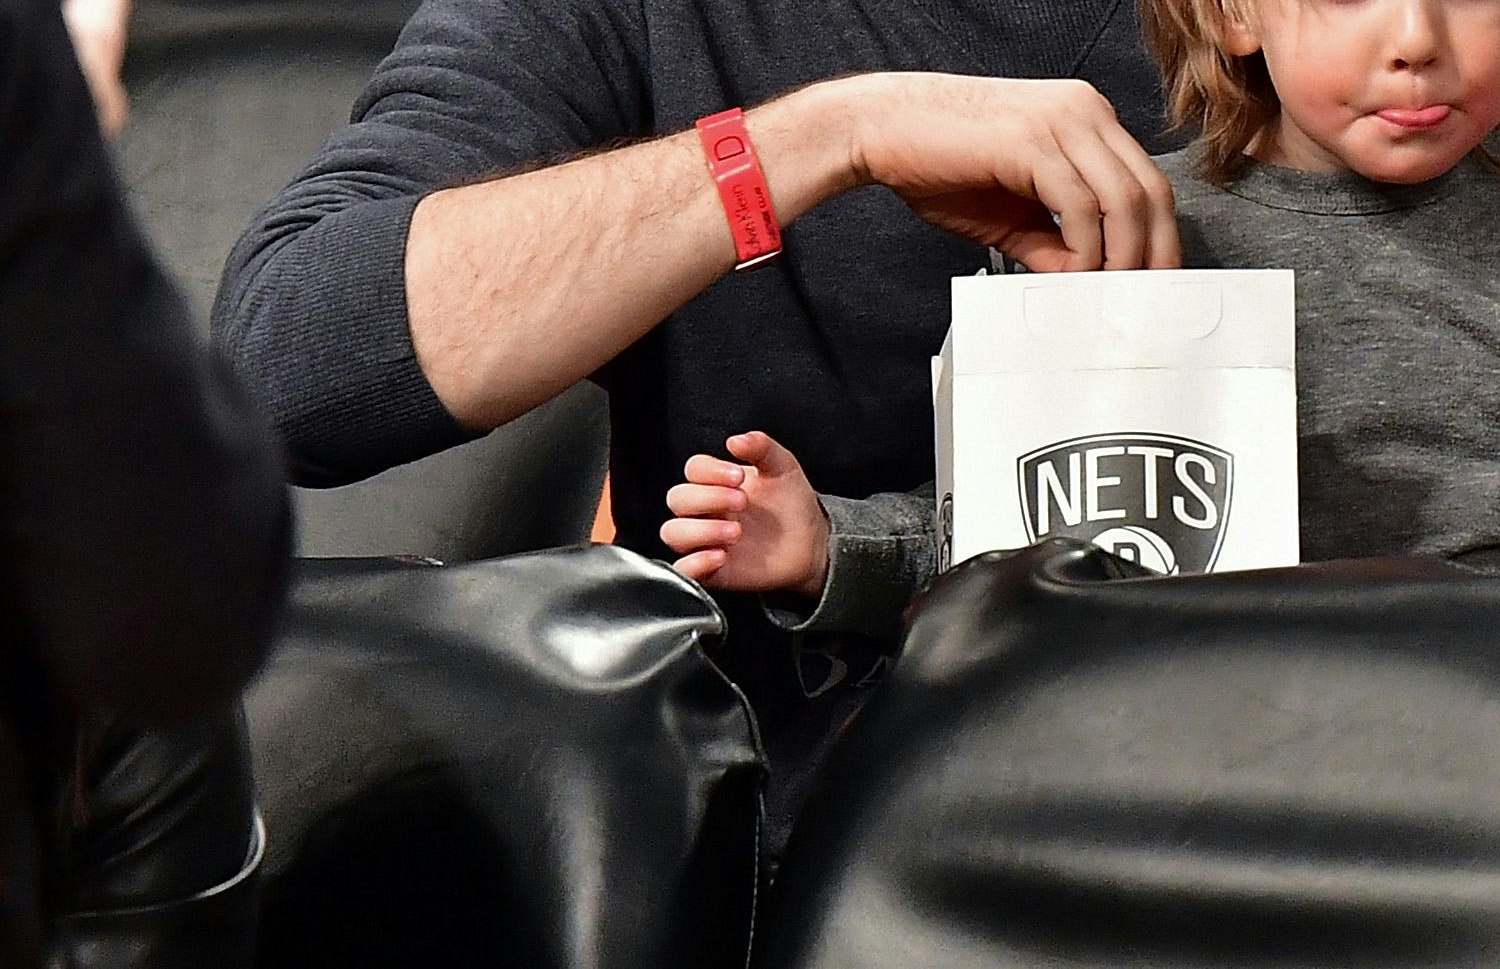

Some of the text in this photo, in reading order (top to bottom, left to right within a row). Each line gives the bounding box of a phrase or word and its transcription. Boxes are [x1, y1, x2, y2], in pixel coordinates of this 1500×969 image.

[714, 135, 746, 162] D
[733, 184, 753, 223] Klein
[1037, 446, 1219, 536] NETS
